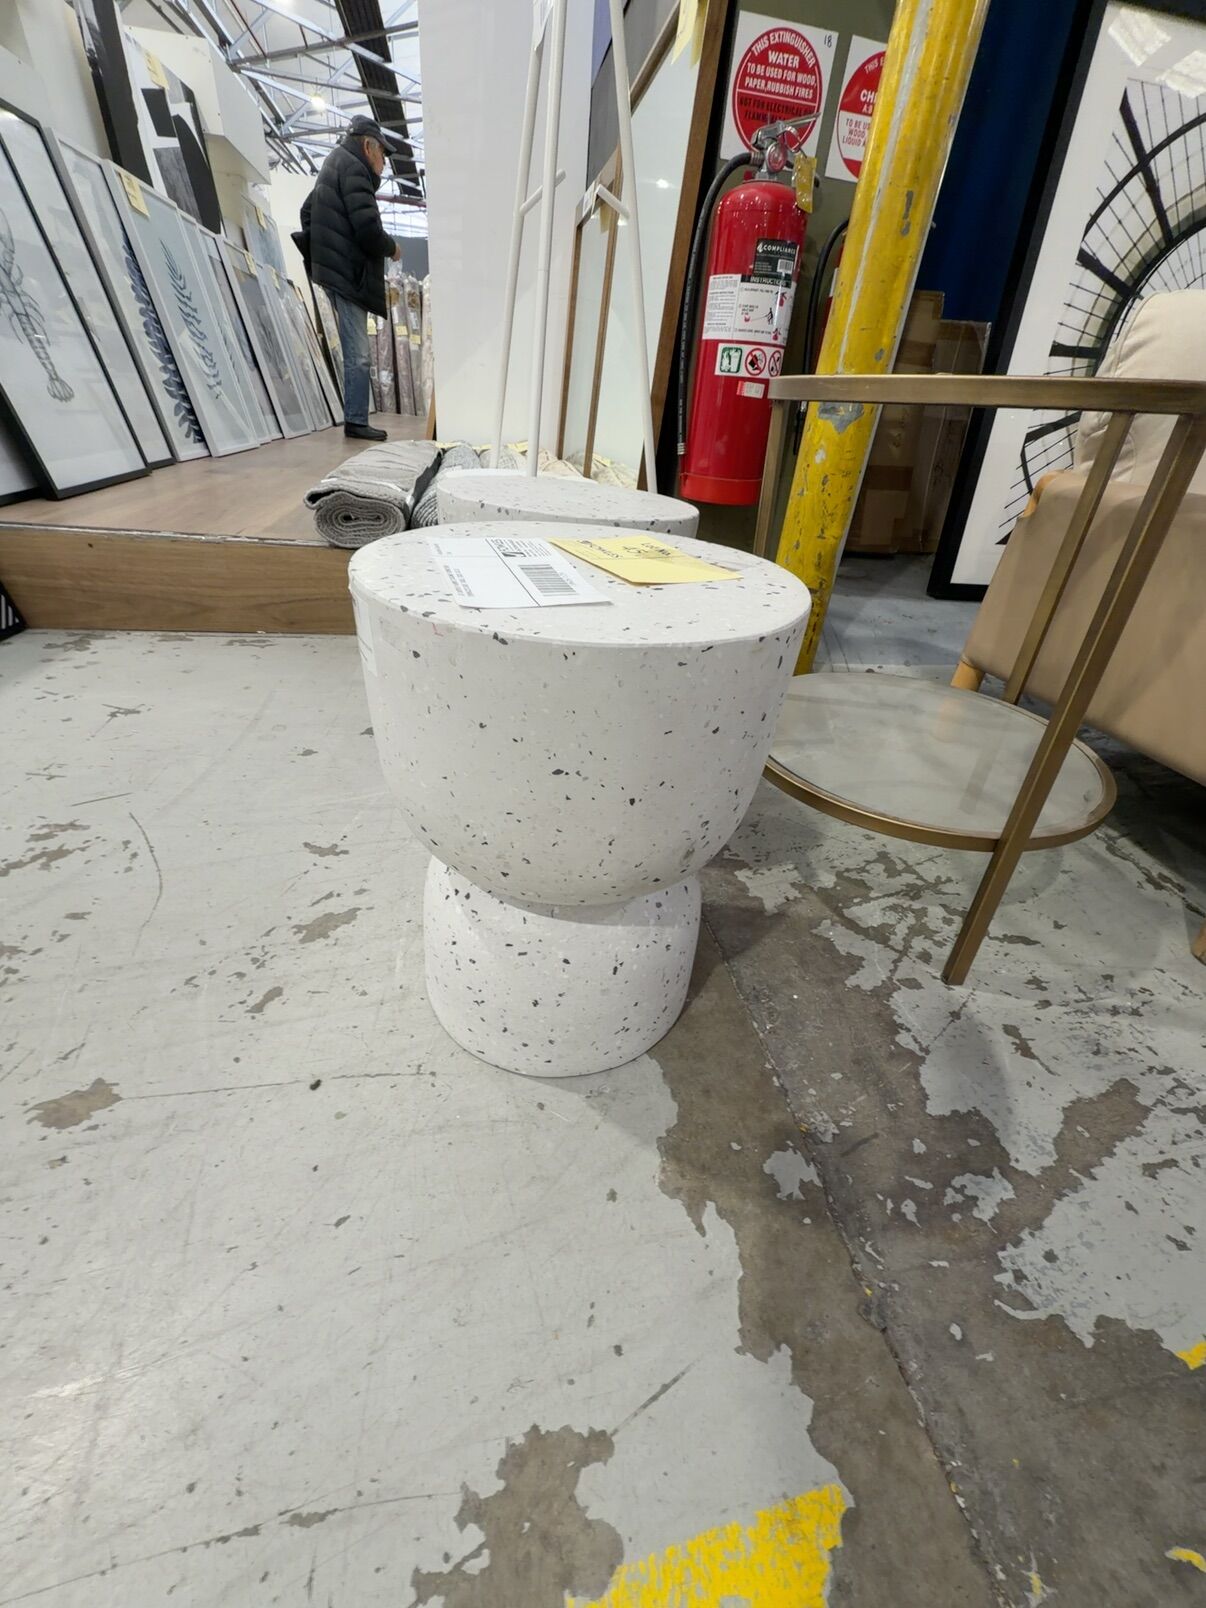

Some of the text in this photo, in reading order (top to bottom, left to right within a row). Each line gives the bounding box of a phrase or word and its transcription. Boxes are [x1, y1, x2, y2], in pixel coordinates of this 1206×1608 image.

[824, 34, 833, 48] 18
[752, 31, 816, 68] THIS EXTINGUISHER
[768, 50, 800, 68] WATER
[864, 58, 879, 75] THIS
[747, 62, 757, 74] TO
[756, 64, 765, 76] BE
[766, 66, 783, 79] USED
[783, 69, 796, 82] FOR
[795, 87, 814, 99] FIRES
[739, 96, 753, 107] NOT
[753, 98, 766, 109] FOR
[766, 101, 802, 117] ELECTRICAL
[846, 118, 853, 127] TO
[854, 120, 862, 129] BE
[842, 135, 862, 146] LIQUID
[763, 244, 796, 254] COMPLIANCE
